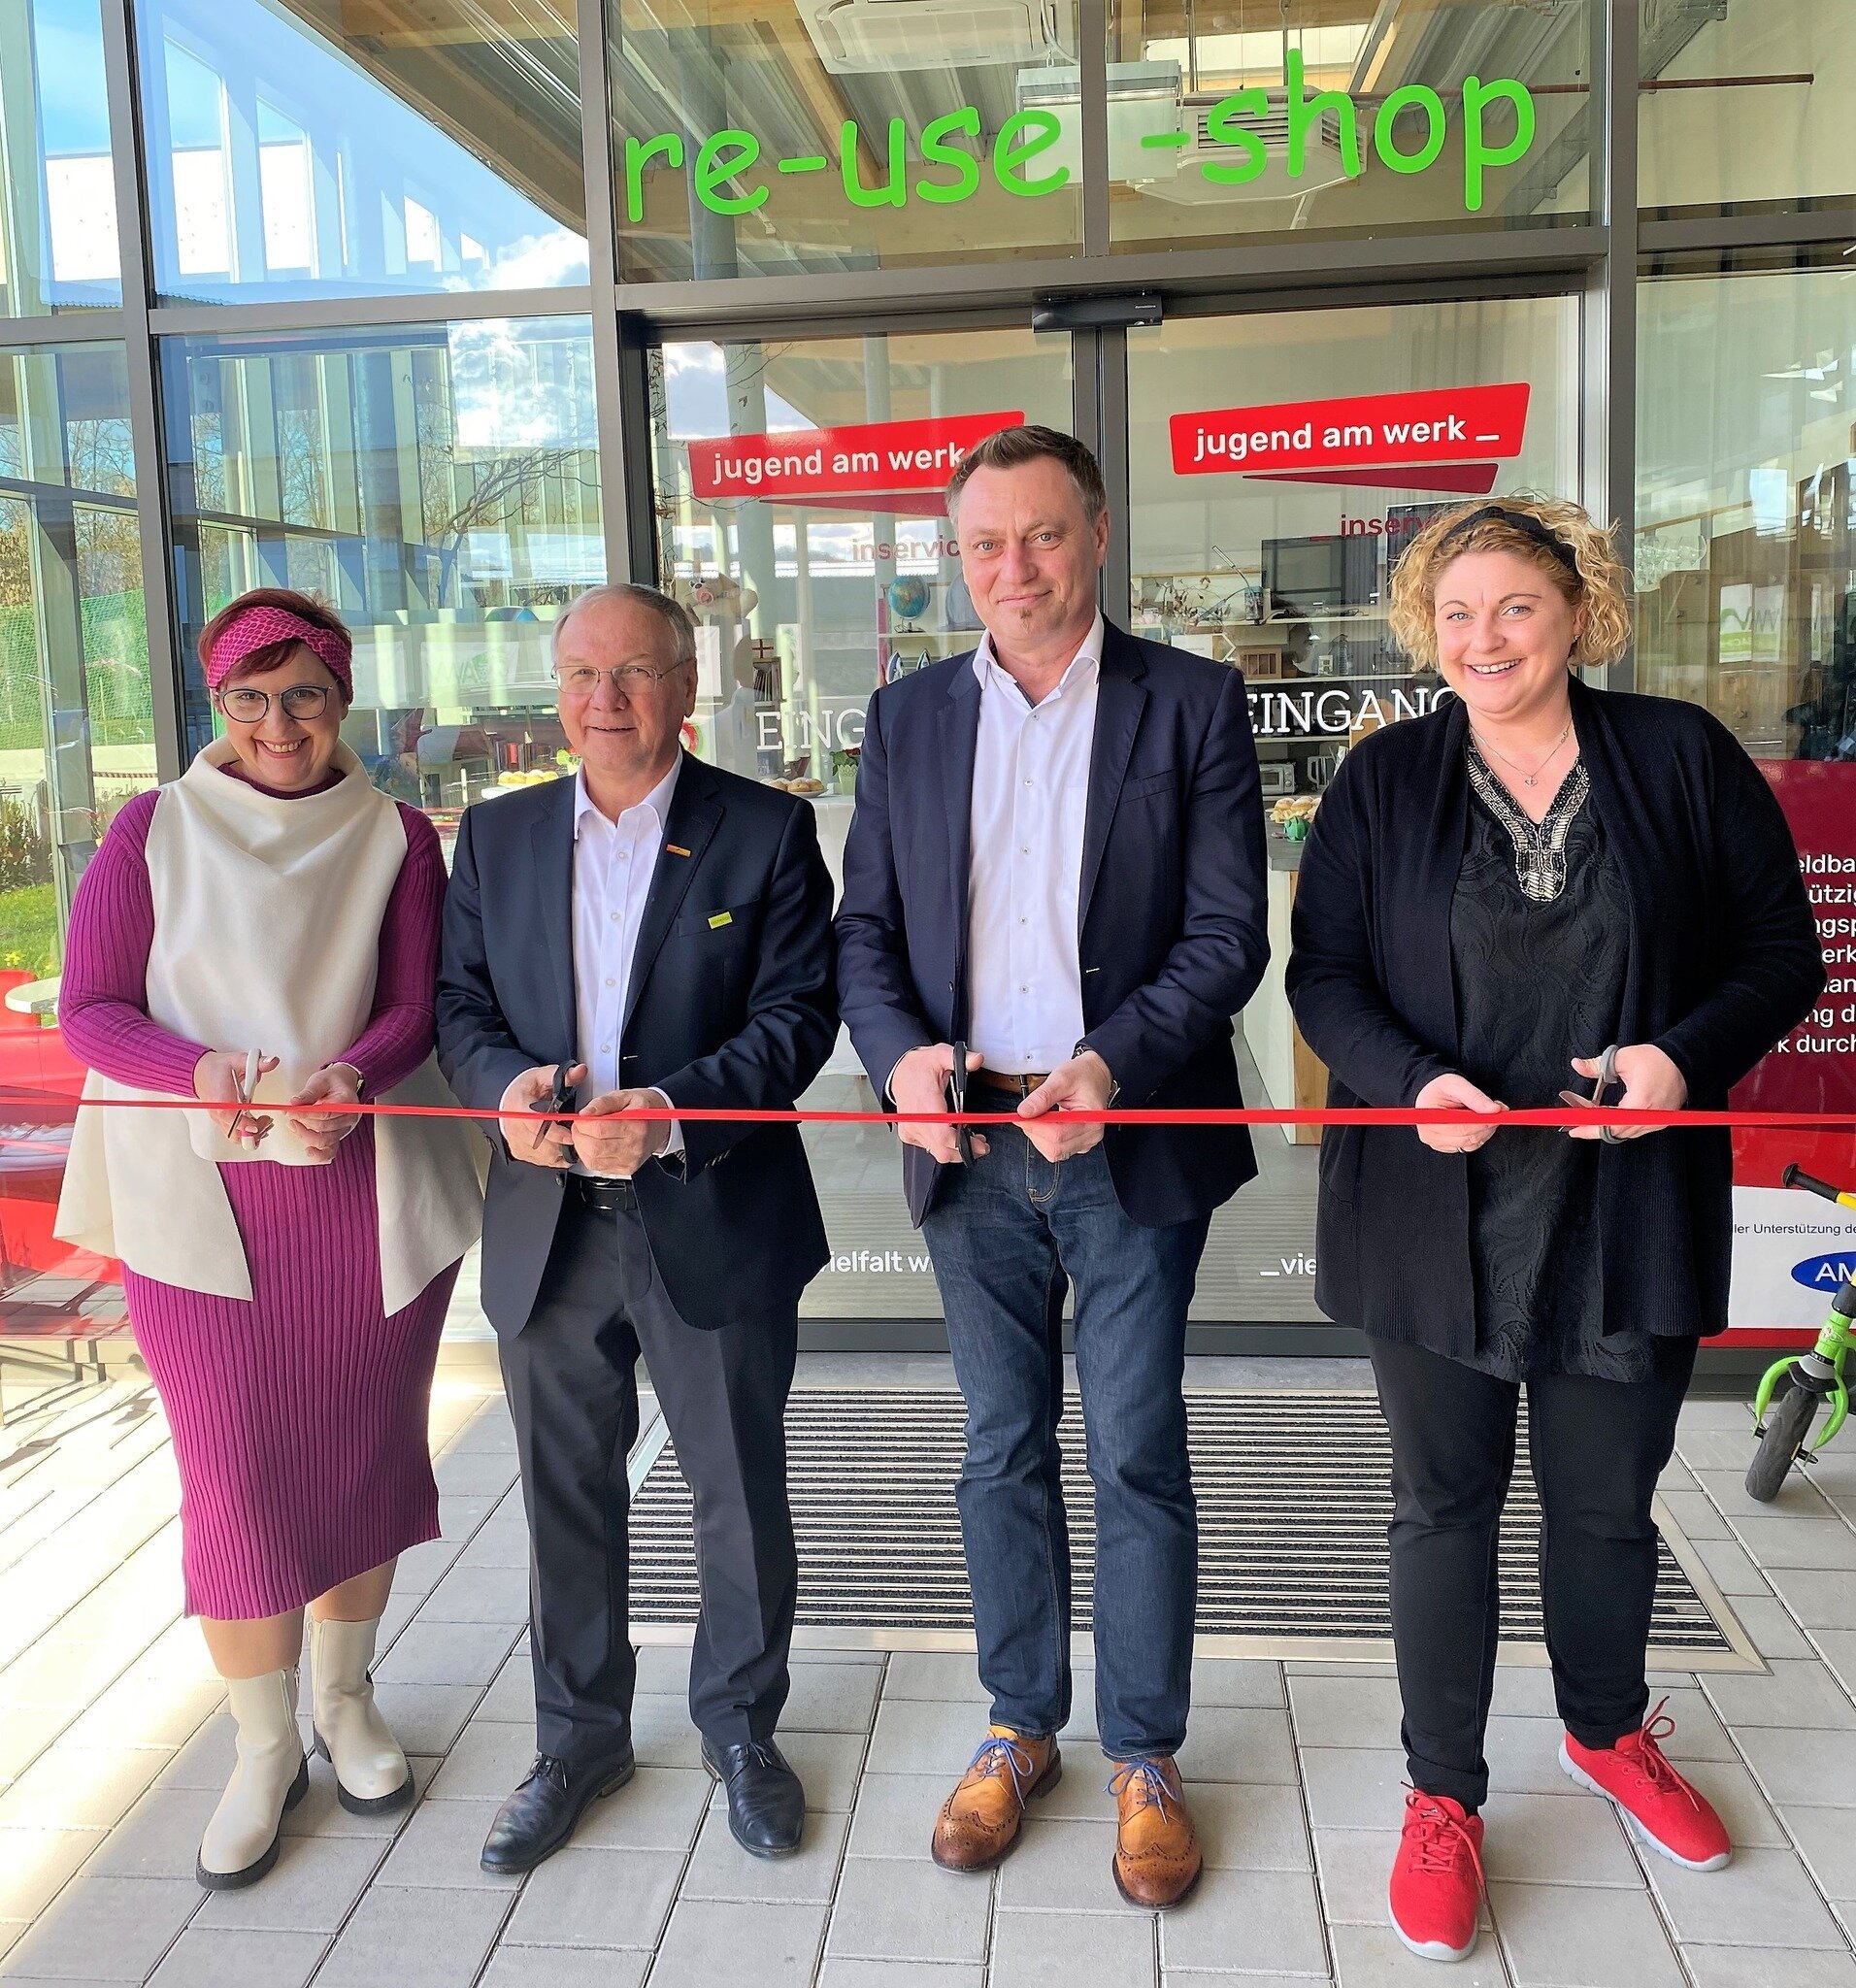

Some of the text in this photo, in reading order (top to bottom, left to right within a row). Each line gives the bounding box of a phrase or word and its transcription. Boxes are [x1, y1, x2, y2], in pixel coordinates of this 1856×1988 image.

[624, 106, 1070, 222] re-use
[1194, 422, 1312, 462] jugend
[1321, 424, 1374, 448] am
[1382, 414, 1467, 444] werk
[712, 442, 966, 485] jugend am werk
[1808, 883, 1856, 907] ützi
[1753, 1224, 1840, 1236] Unterstützung
[820, 1250, 904, 1273] ielfalt
